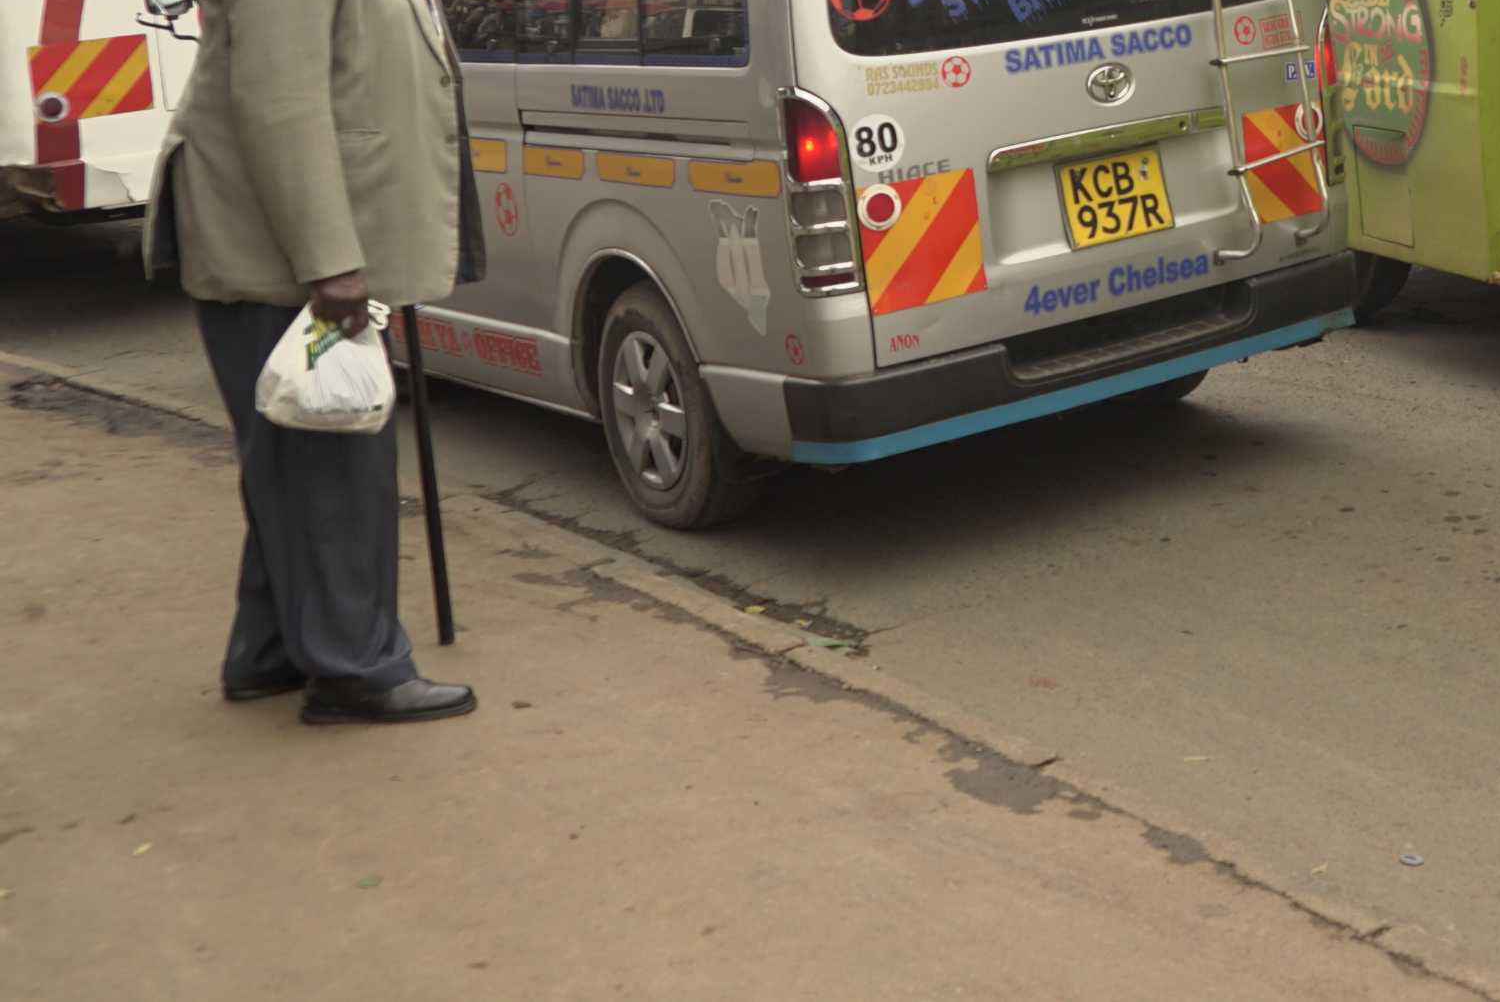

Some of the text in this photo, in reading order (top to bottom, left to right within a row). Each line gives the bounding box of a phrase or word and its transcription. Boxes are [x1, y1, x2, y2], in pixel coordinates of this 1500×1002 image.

[1005, 24, 1192, 74] SATIMA SACCO
[854, 121, 899, 158] 80
[868, 153, 893, 166] KPH
[878, 158, 951, 185] HIACE
[1068, 161, 1135, 205] KCB
[1077, 193, 1165, 239] 937R
[1023, 253, 1209, 316] 4ever Chelsea
